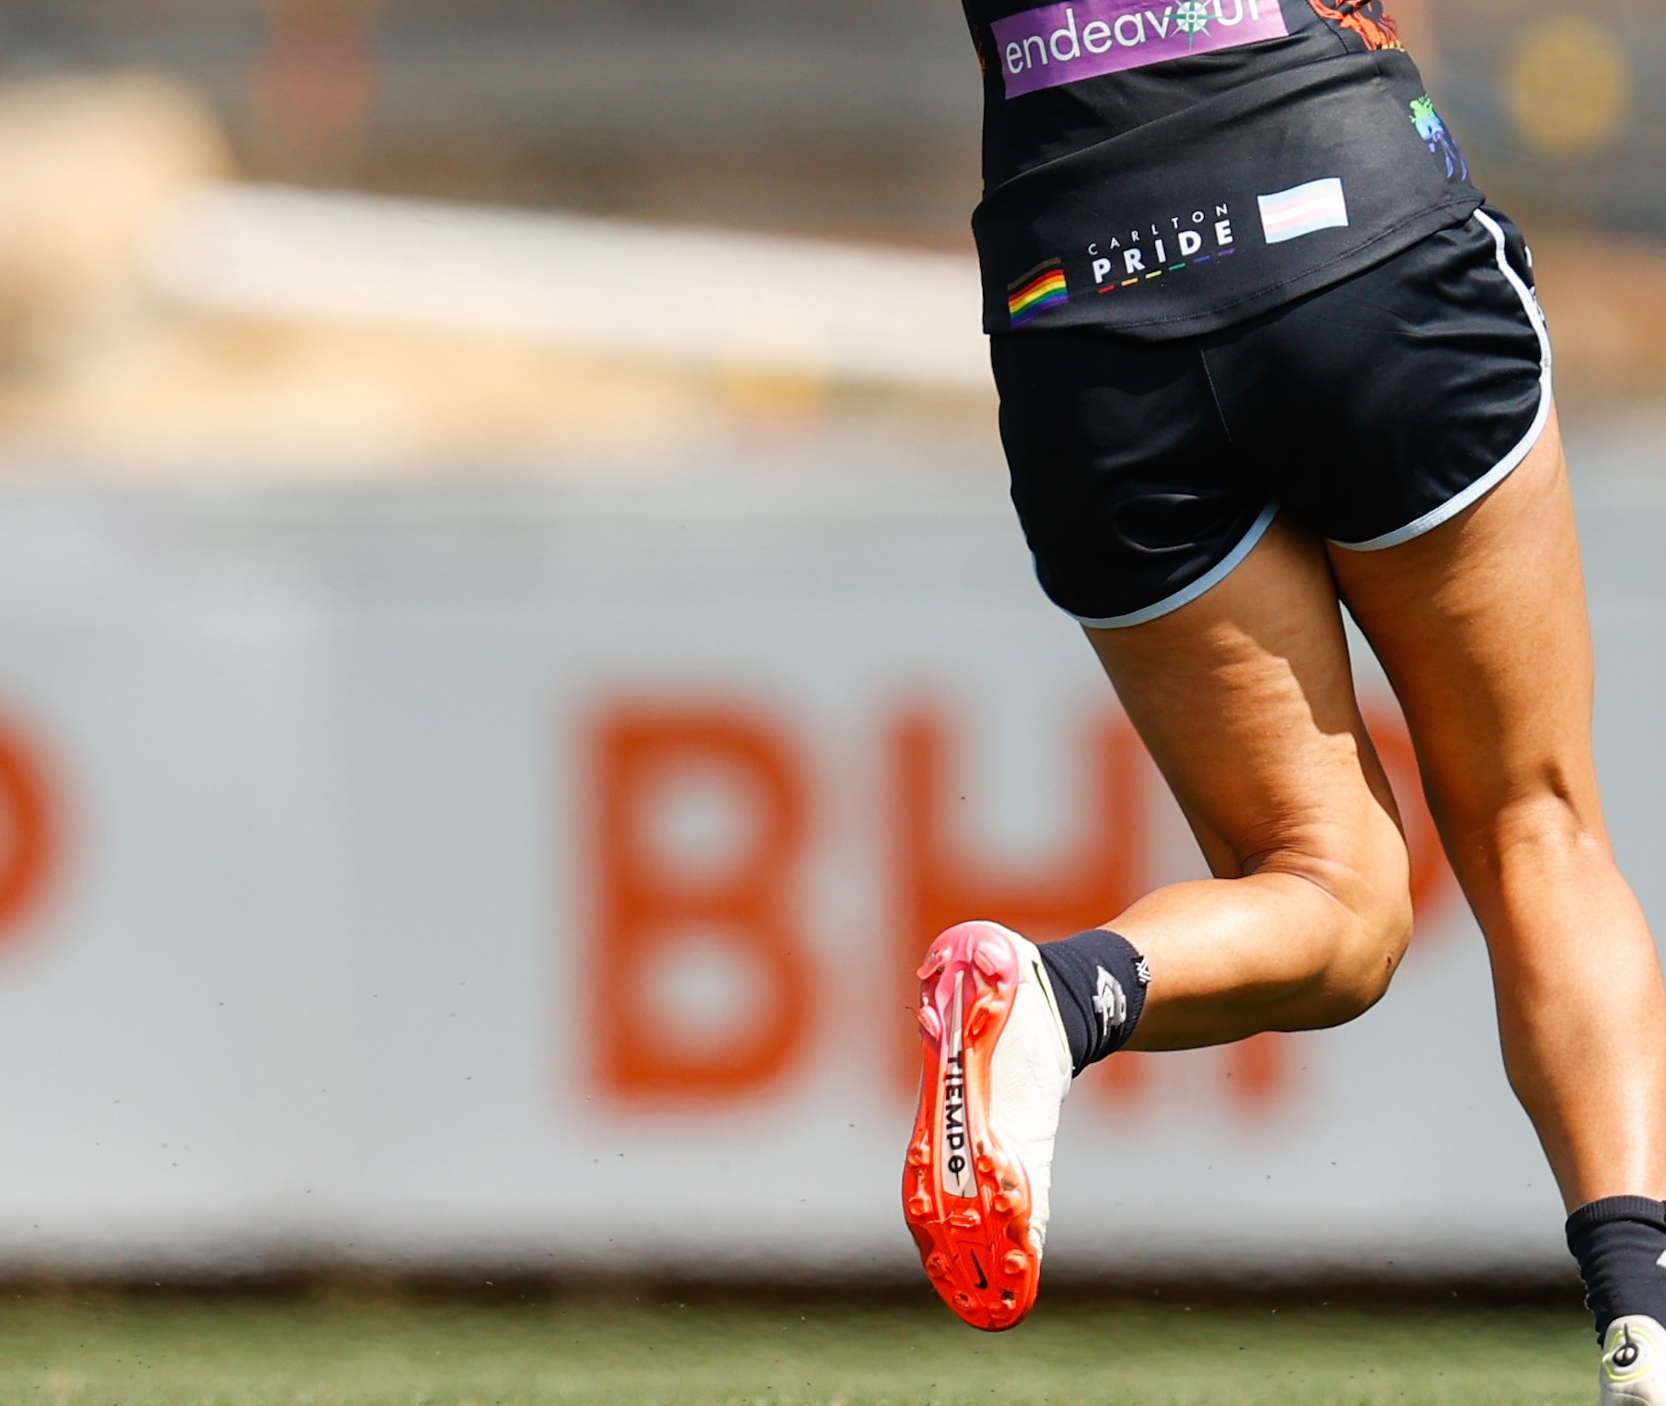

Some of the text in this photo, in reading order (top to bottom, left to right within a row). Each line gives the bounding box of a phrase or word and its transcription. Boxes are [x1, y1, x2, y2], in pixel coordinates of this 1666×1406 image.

[1087, 203, 1229, 256] CARLTON
[1091, 219, 1234, 284] PRIDE
[945, 1050, 965, 1186] TIEMPO
